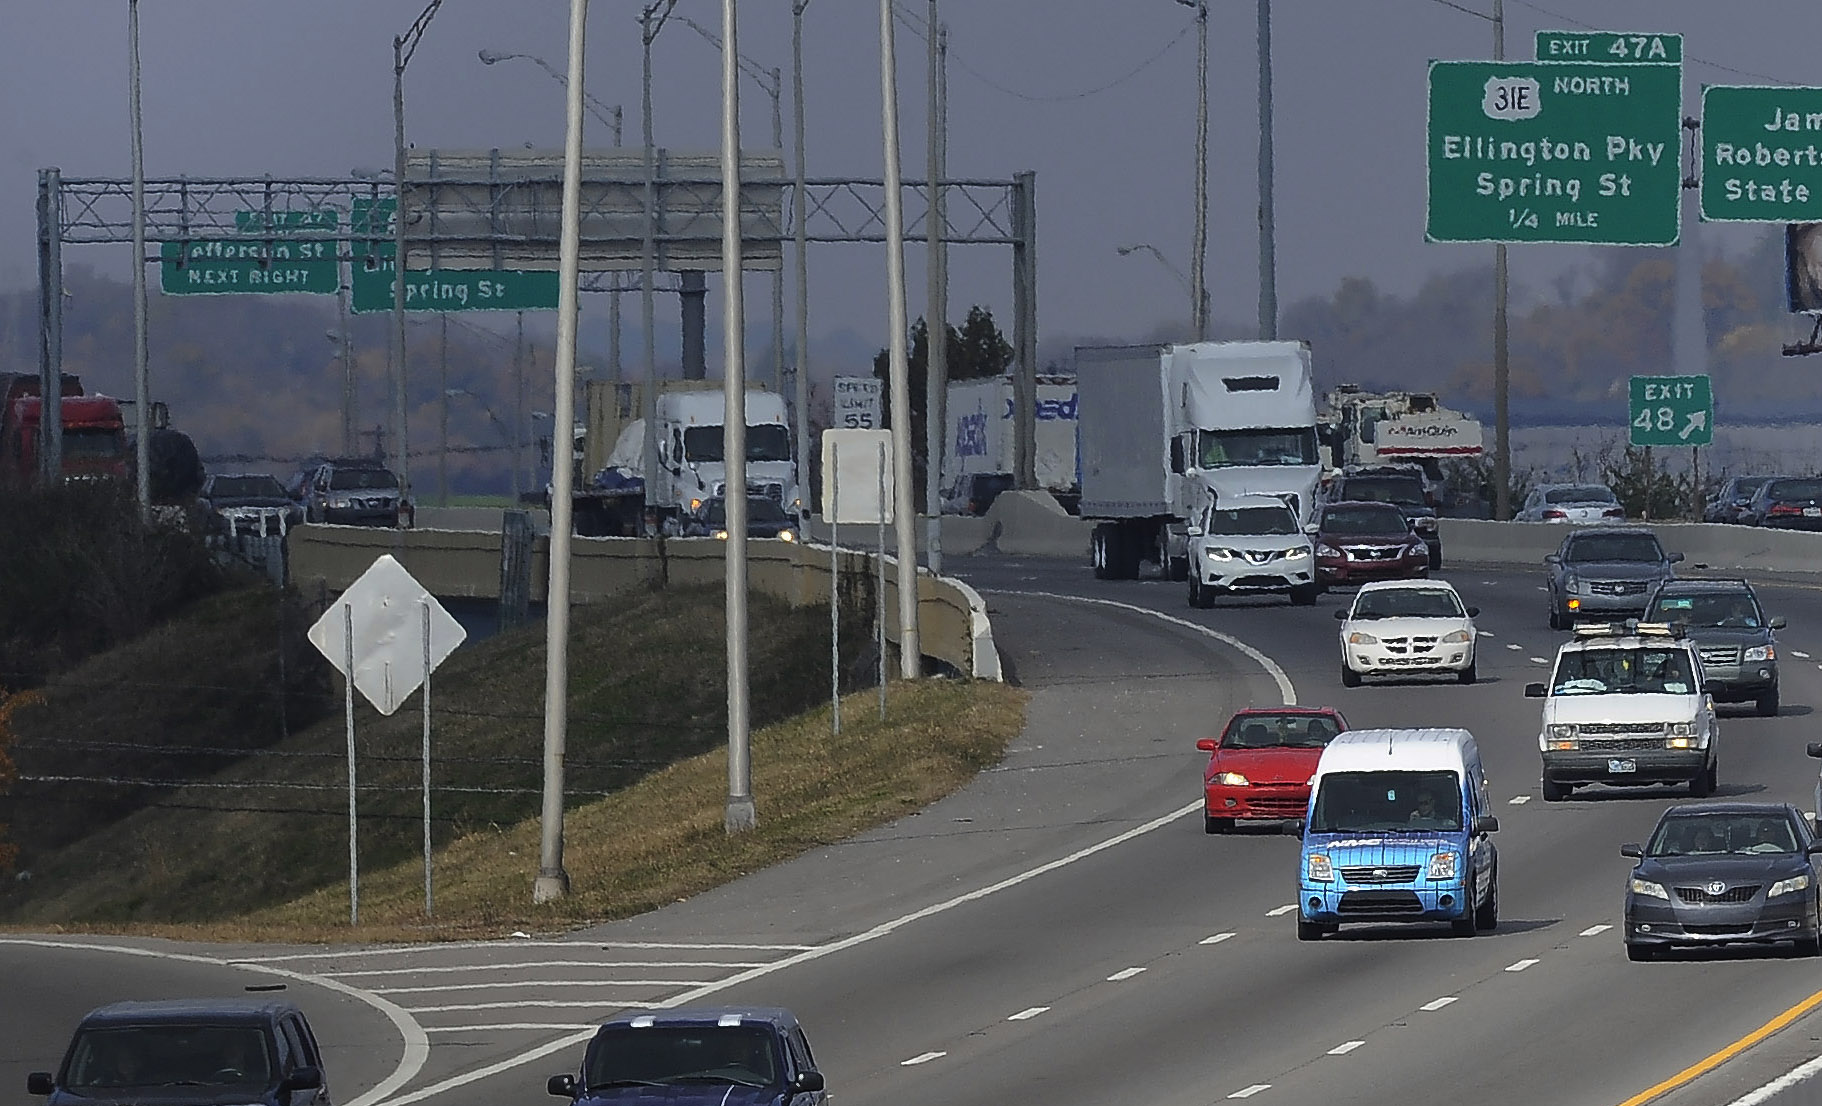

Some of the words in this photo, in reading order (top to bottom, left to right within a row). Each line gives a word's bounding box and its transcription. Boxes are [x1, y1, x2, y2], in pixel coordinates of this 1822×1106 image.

[1549, 39, 1590, 55] EXIT
[1608, 36, 1667, 59] 47A
[1553, 76, 1631, 96] NORTH
[1494, 86, 1531, 112] 31E
[1443, 135, 1591, 167] Ellington
[1606, 135, 1665, 167] Pky
[1476, 171, 1581, 202] Spring
[1598, 173, 1632, 197] St
[1724, 178, 1810, 203] State
[249, 212, 288, 225] EIT
[1556, 211, 1599, 228] MILE
[299, 242, 324, 259] St
[188, 269, 240, 285] NEXT
[249, 269, 309, 285] RIGHT
[478, 279, 506, 299] St
[1645, 383, 1694, 401] EXIT
[844, 412, 873, 430] 55
[1633, 407, 1675, 432] 48
